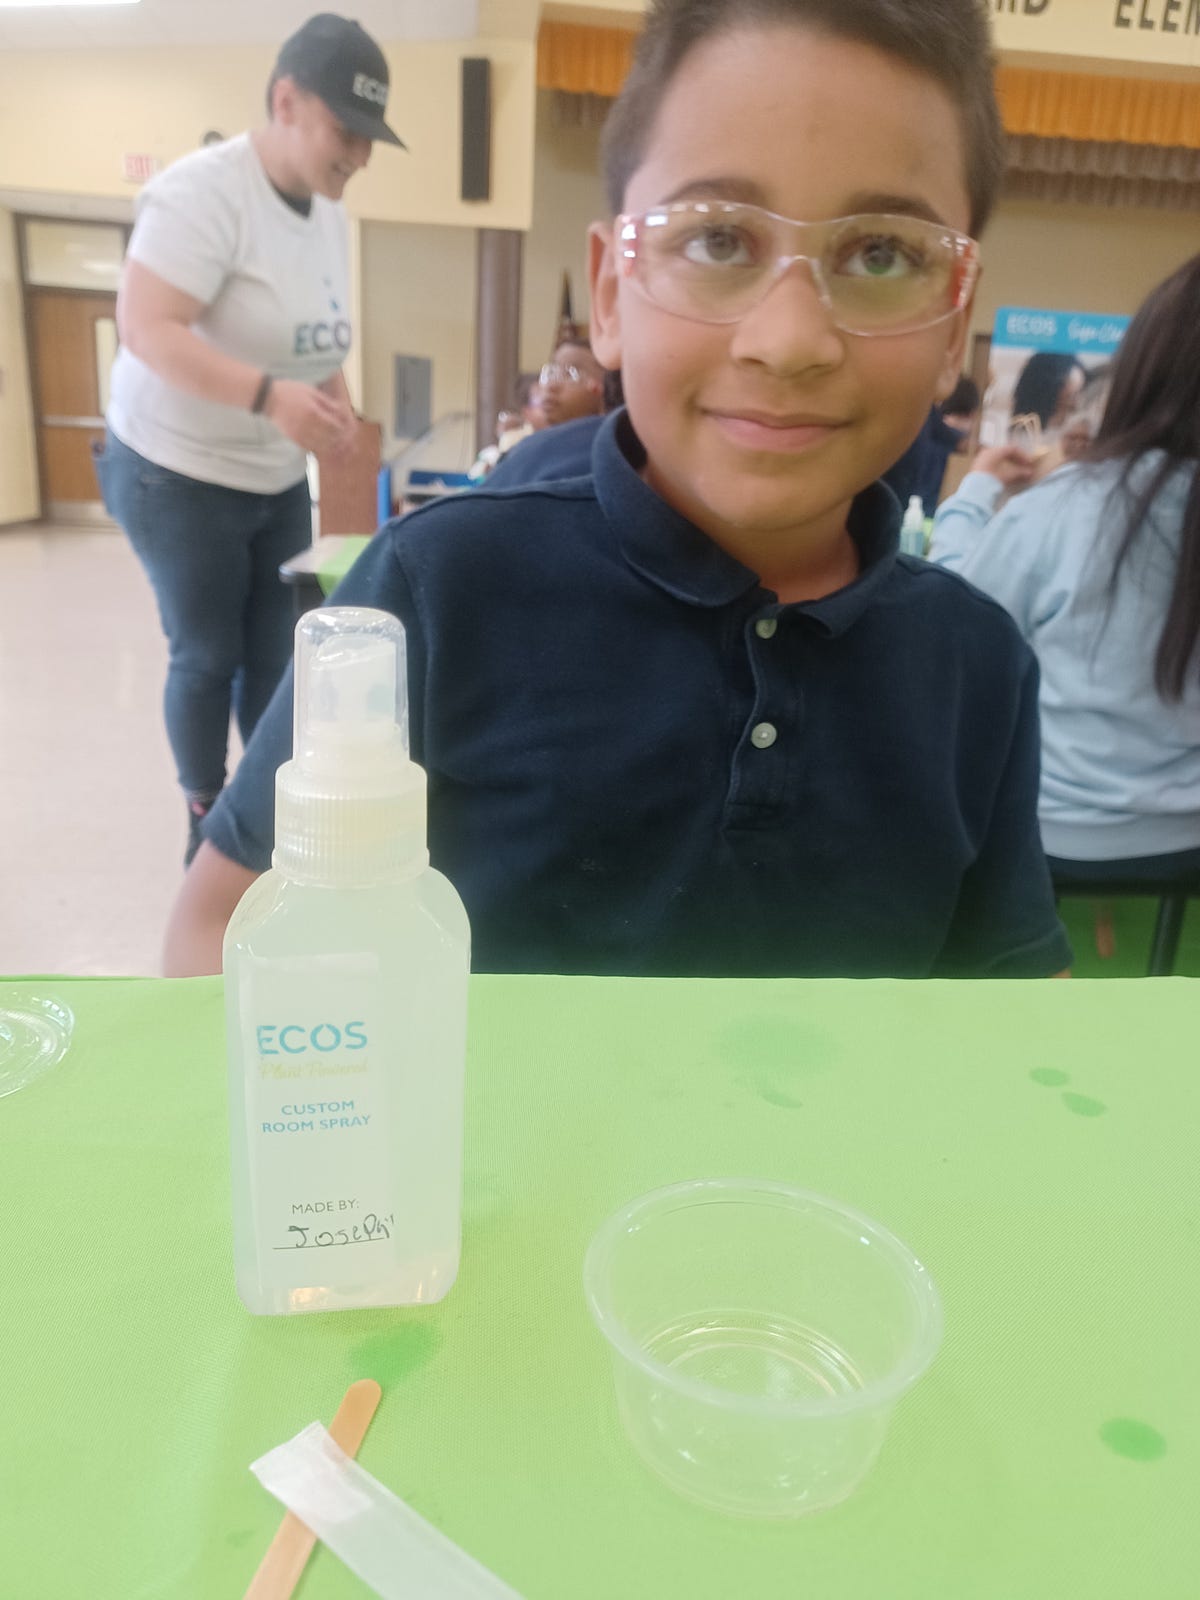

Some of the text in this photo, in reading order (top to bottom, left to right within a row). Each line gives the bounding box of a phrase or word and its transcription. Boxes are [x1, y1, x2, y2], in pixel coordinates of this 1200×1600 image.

[256, 1021, 368, 1055] ECOS
[281, 1101, 355, 1116] CUSTOM
[261, 1114, 371, 1133] ROOM SPRAY
[292, 1199, 360, 1215] MADE BY:
